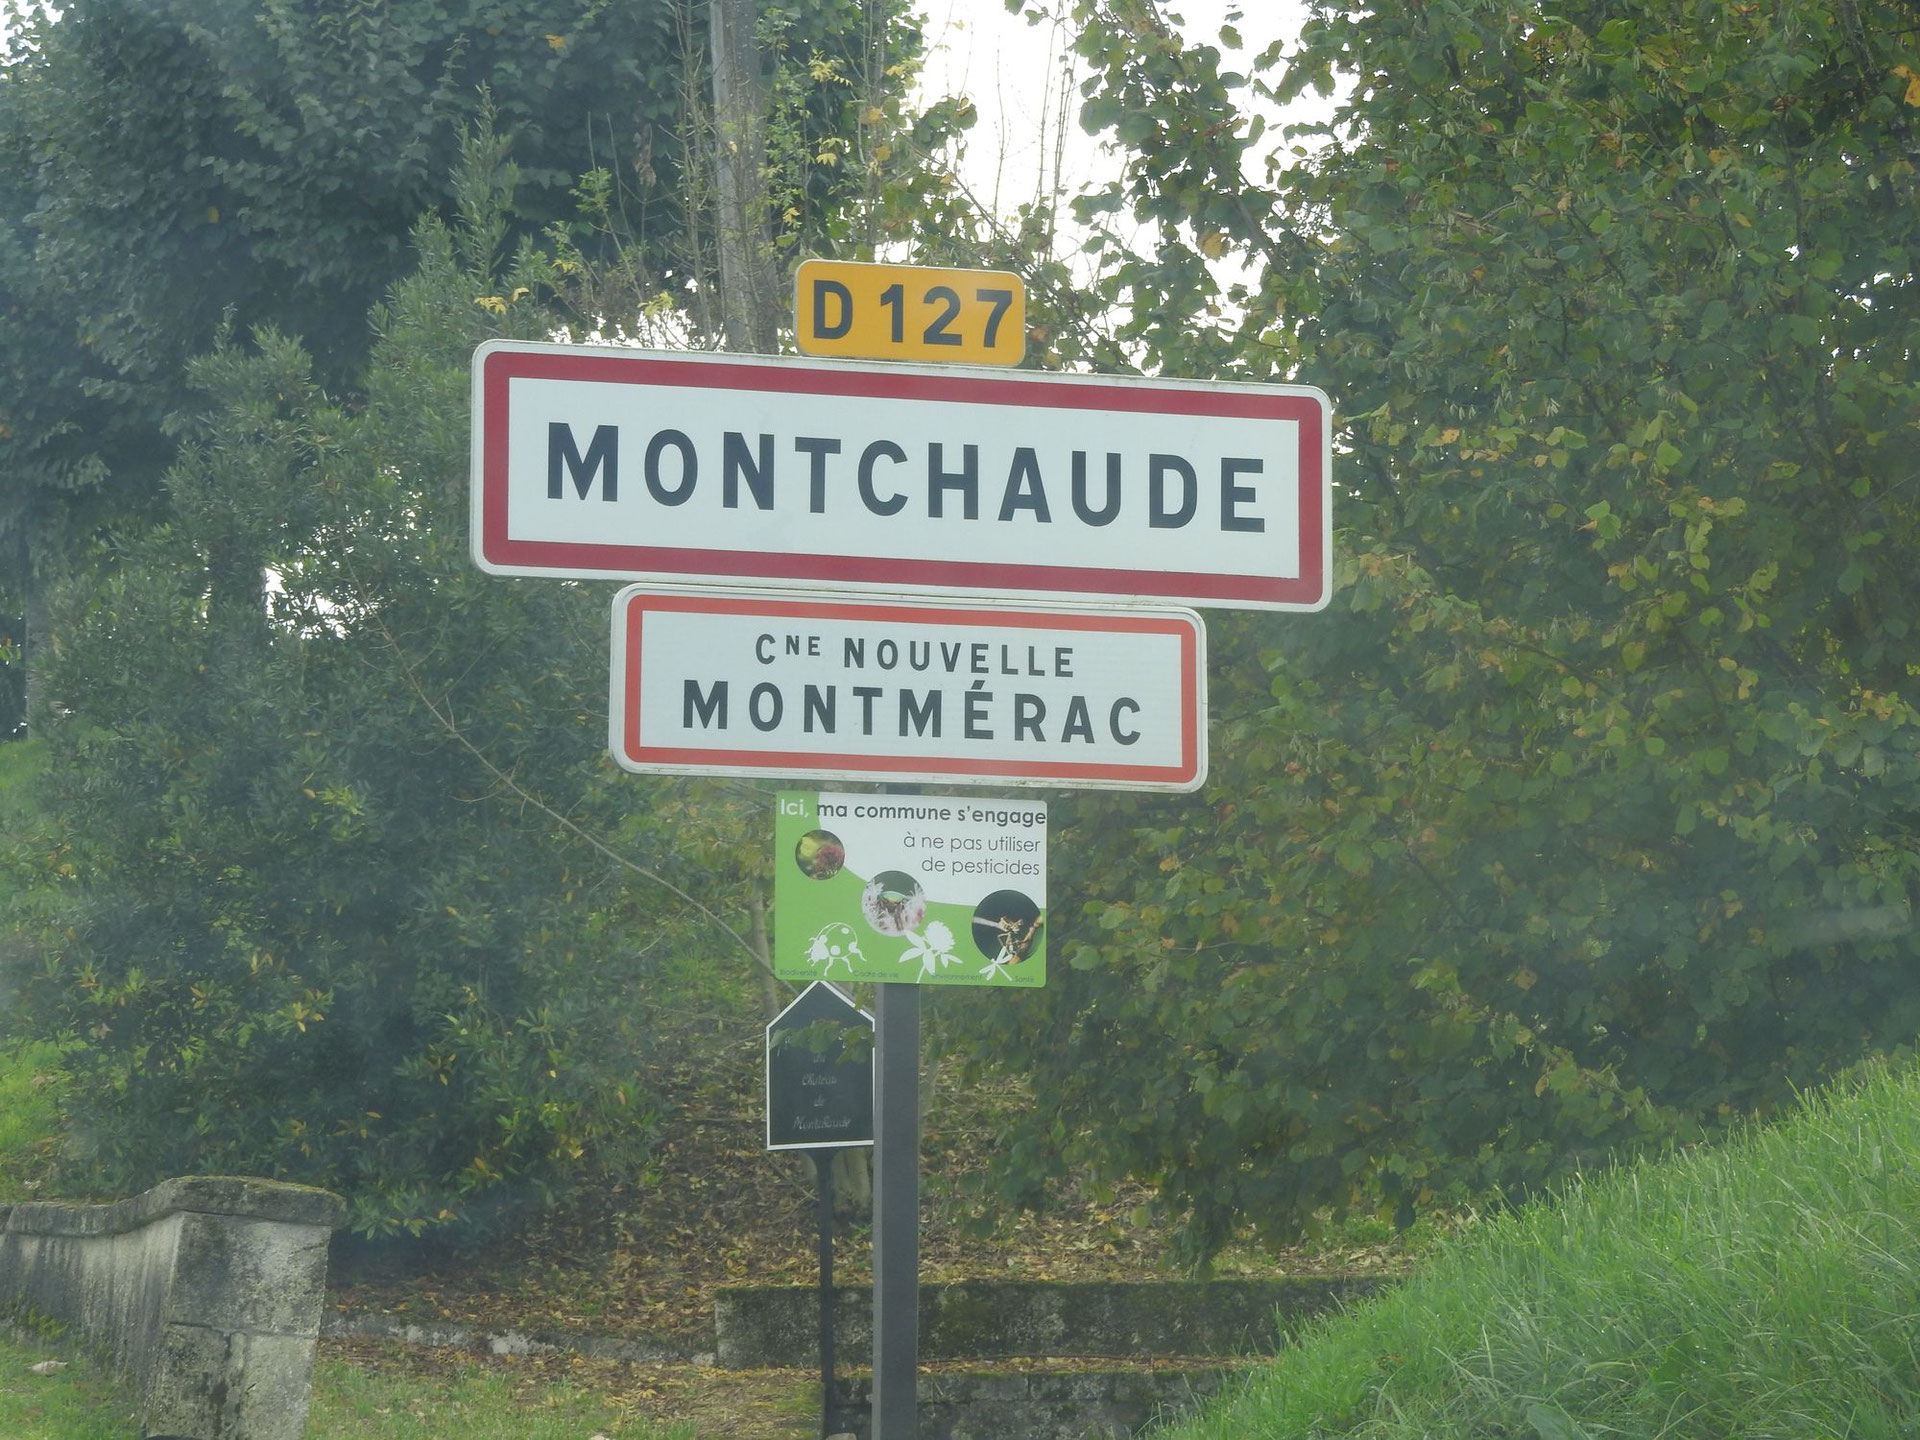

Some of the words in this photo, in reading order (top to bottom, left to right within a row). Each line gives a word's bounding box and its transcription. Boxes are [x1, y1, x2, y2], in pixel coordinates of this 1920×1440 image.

[813, 280, 854, 339] D
[879, 283, 1014, 349] 127
[547, 422, 1266, 533] MONTCHAUDE
[843, 637, 1074, 678] NOUVELLE
[683, 679, 1141, 746] MONTMÉRAC
[780, 799, 809, 818] Ici,
[817, 803, 848, 818] ma
[854, 805, 951, 821] commune
[957, 805, 1046, 828] s'engage
[903, 831, 915, 848] à
[921, 836, 944, 849] ne
[950, 837, 982, 853] pas
[988, 835, 1041, 852] utiliser
[921, 856, 946, 872] de
[951, 858, 1040, 876] pesticides
